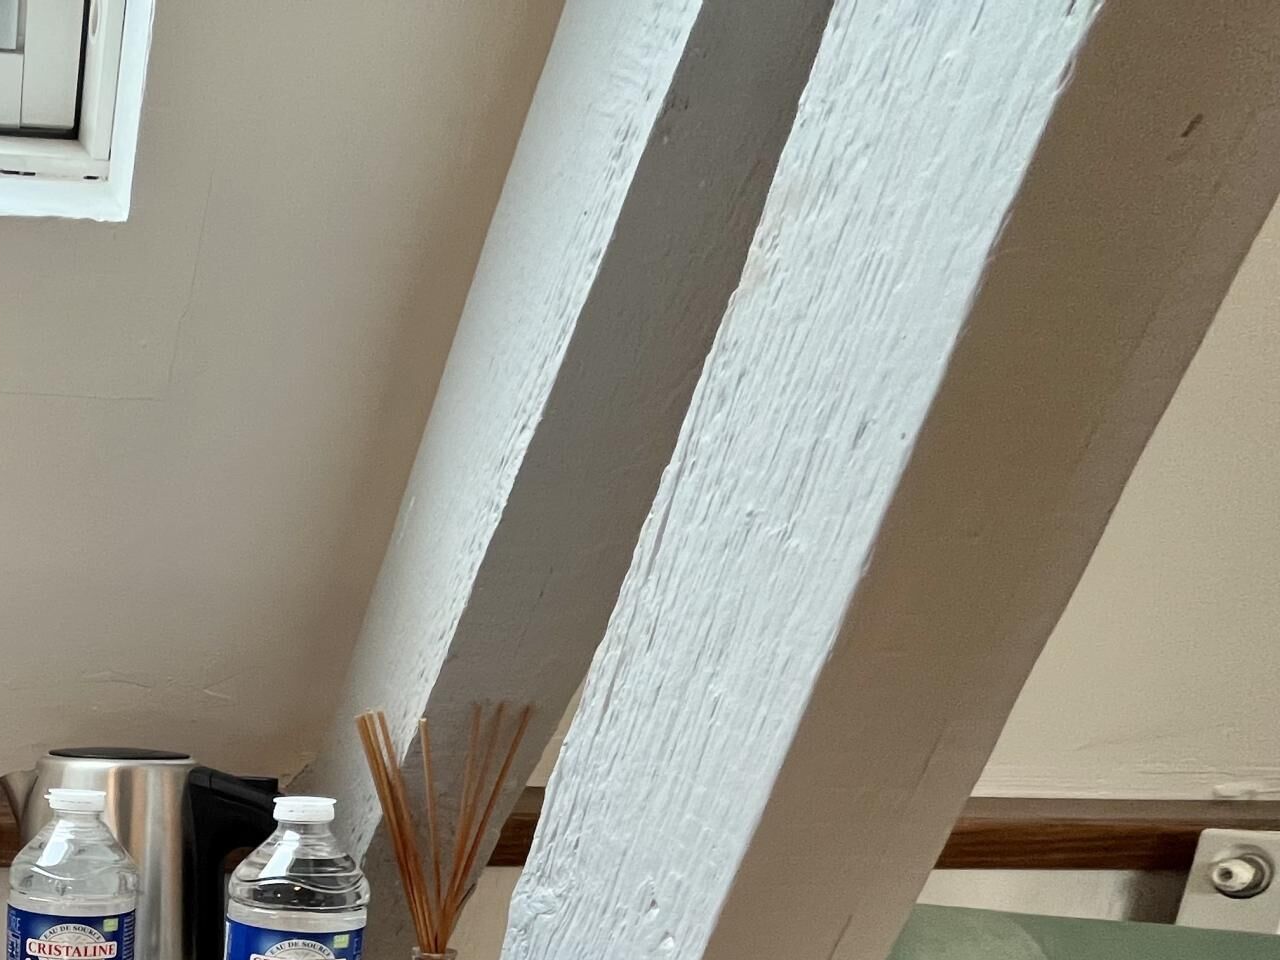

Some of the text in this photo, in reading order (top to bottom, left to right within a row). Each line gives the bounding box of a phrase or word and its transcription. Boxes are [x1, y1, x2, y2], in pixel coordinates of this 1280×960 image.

[44, 926, 59, 940] EAU
[73, 925, 102, 940] SOURCE
[28, 941, 115, 957] CRISTALINE
[270, 944, 286, 955] EAU
[301, 942, 331, 957] SOURCE
